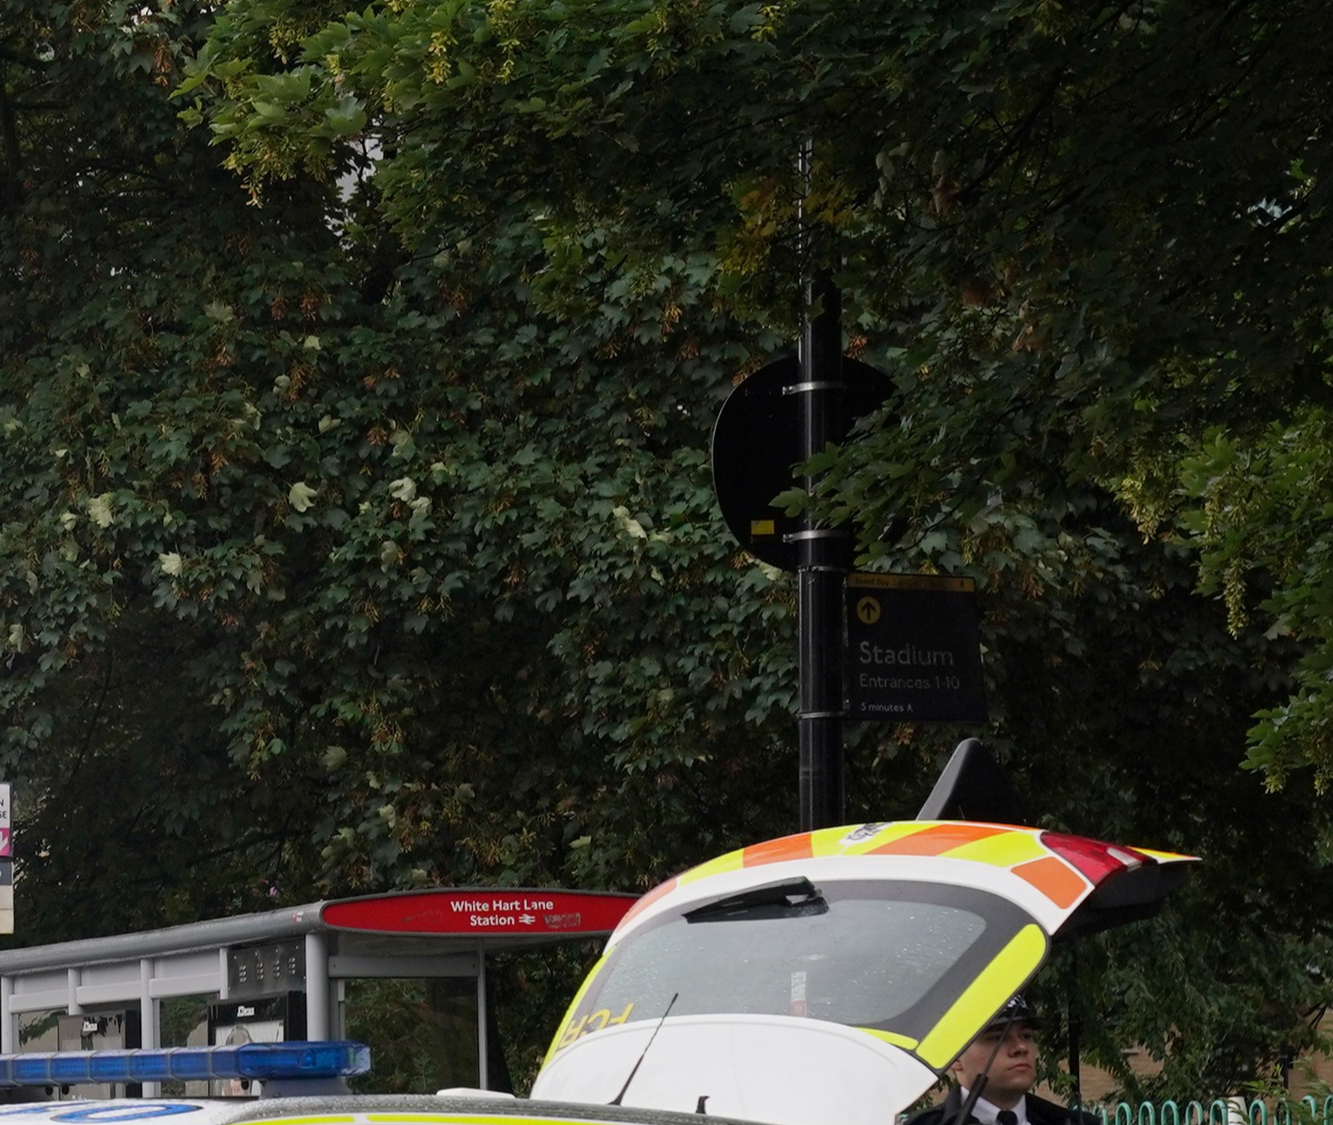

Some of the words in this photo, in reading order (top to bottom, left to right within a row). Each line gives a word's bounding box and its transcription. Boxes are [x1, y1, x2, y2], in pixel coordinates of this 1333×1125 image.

[859, 640, 954, 666] Stadium
[859, 673, 931, 689] Entrances
[935, 675, 960, 690] 1-10
[868, 702, 905, 713] minutes
[450, 900, 489, 912] White
[493, 900, 520, 911] Hart
[523, 899, 553, 911] Lane
[470, 914, 515, 926] Station
